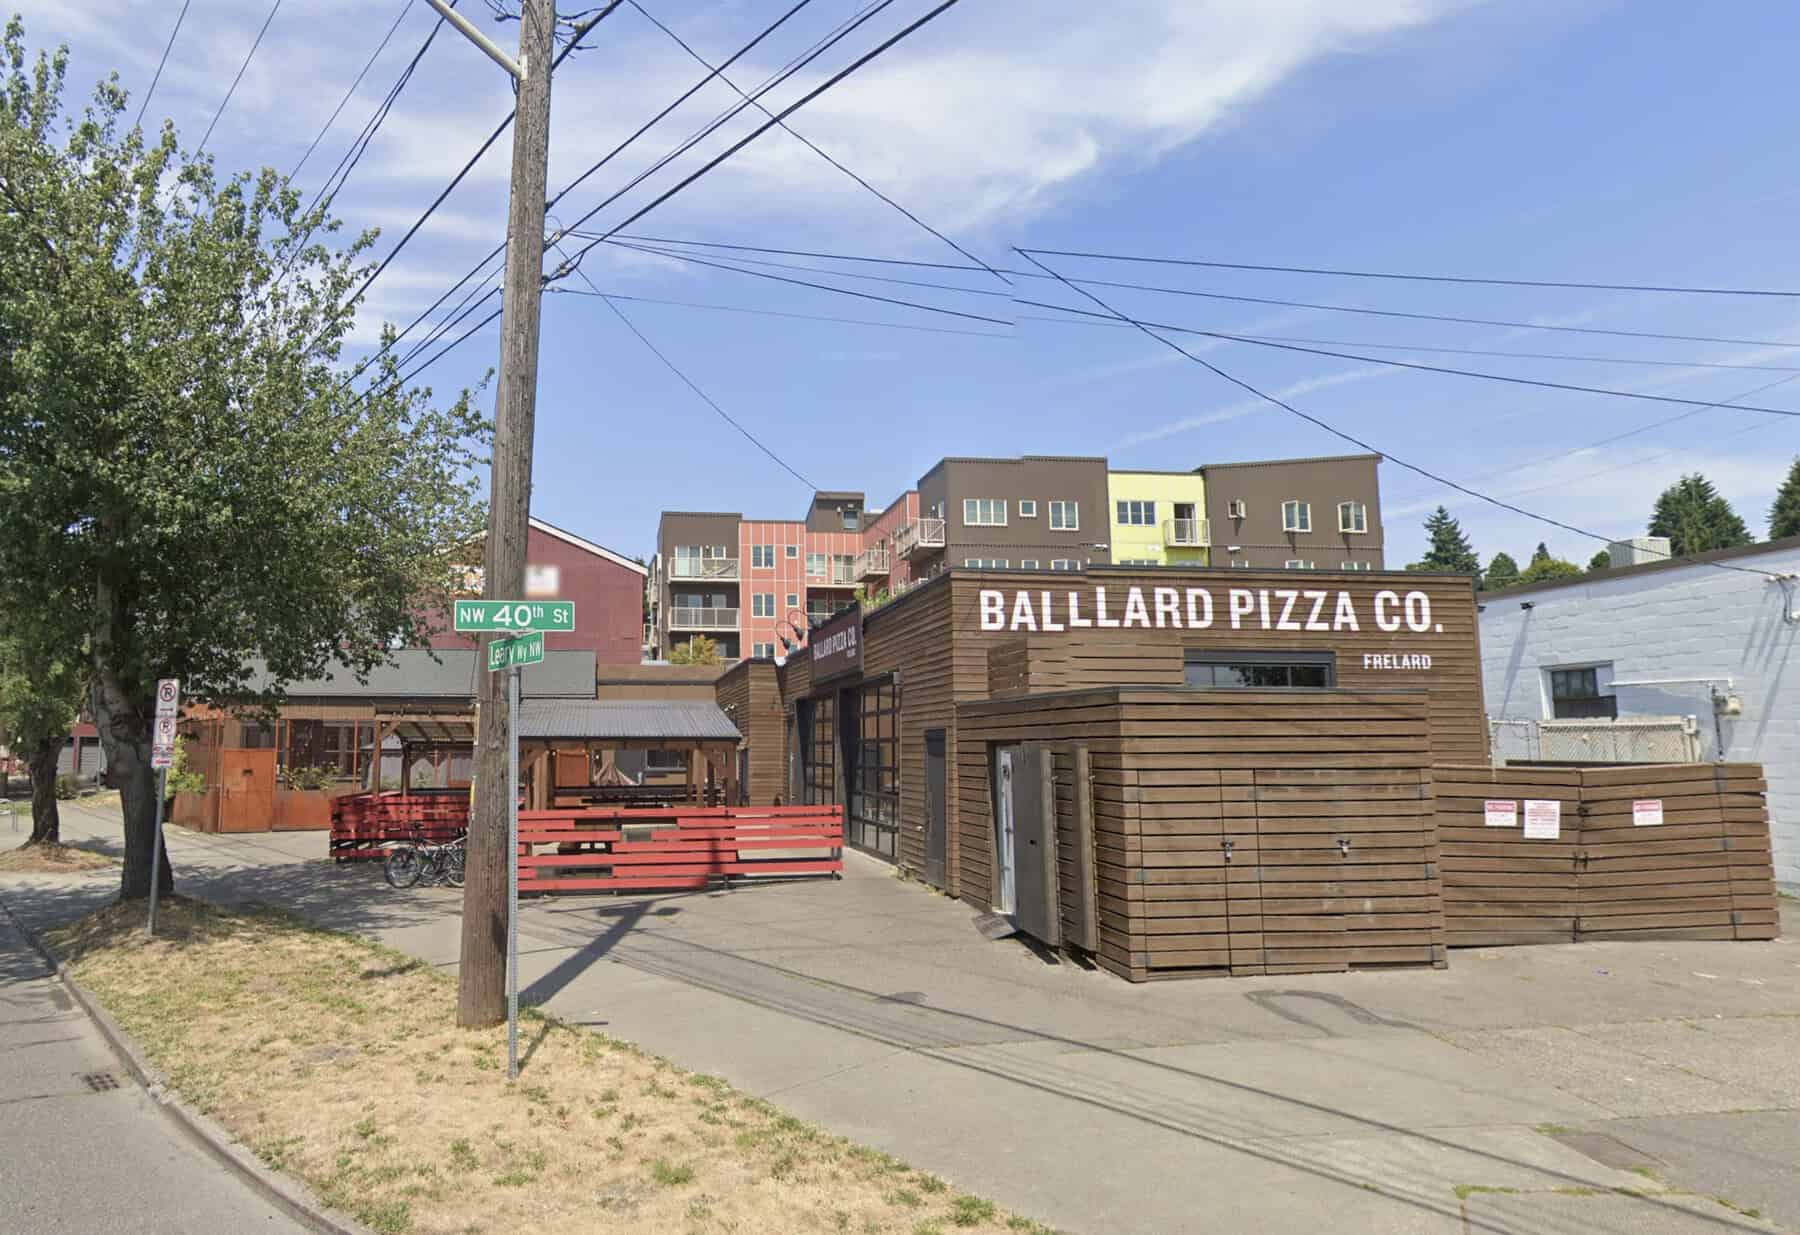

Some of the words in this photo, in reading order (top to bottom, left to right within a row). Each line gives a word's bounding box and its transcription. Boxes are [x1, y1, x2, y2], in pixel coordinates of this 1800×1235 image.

[460, 607, 485, 623] NW
[492, 605, 544, 626] 40th
[553, 608, 568, 624] St
[1229, 588, 1361, 632] PIZZA
[1374, 590, 1444, 633] CO.
[1363, 653, 1432, 670] FRELARD
